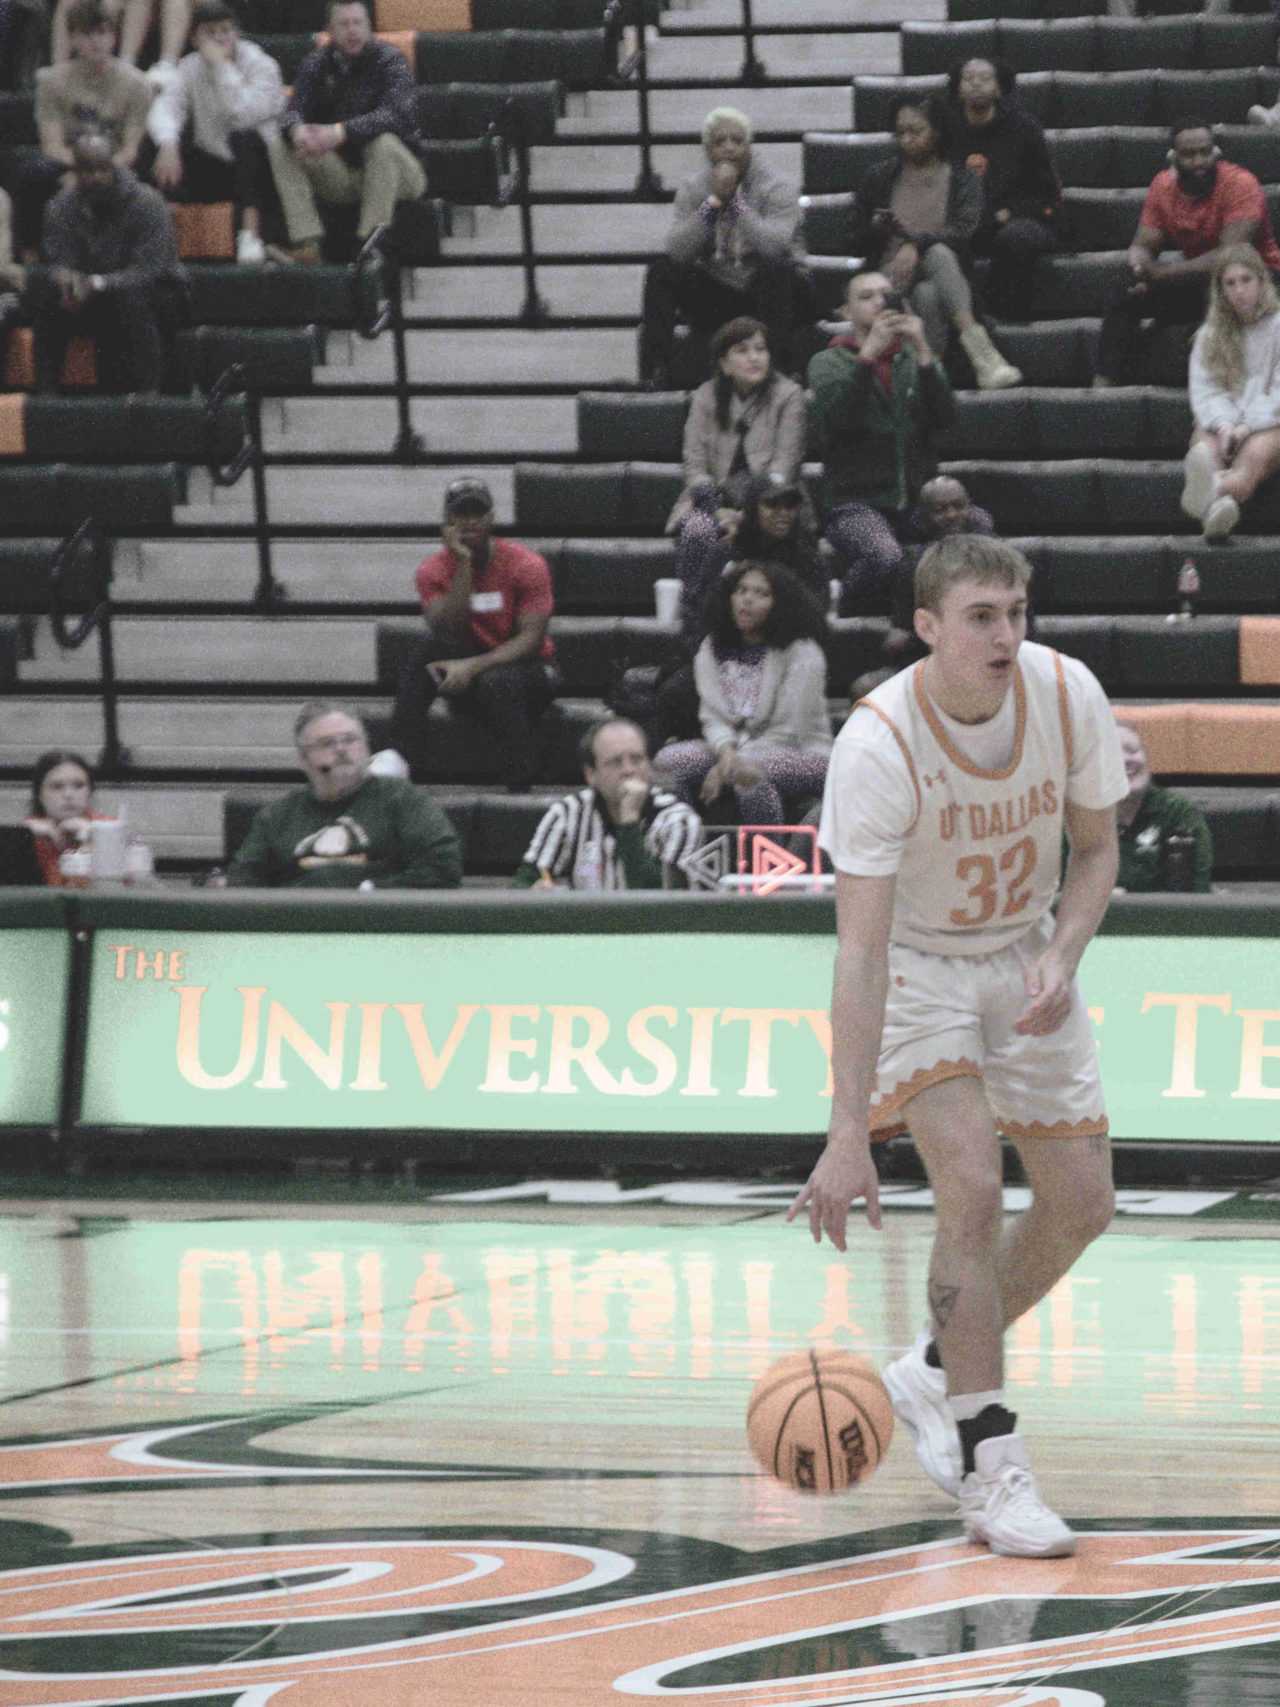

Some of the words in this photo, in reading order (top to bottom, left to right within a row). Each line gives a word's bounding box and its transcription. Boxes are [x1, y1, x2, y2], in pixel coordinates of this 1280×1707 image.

[968, 778, 1057, 841] DALLAS
[949, 834, 1038, 927] 32
[108, 943, 188, 982] THE
